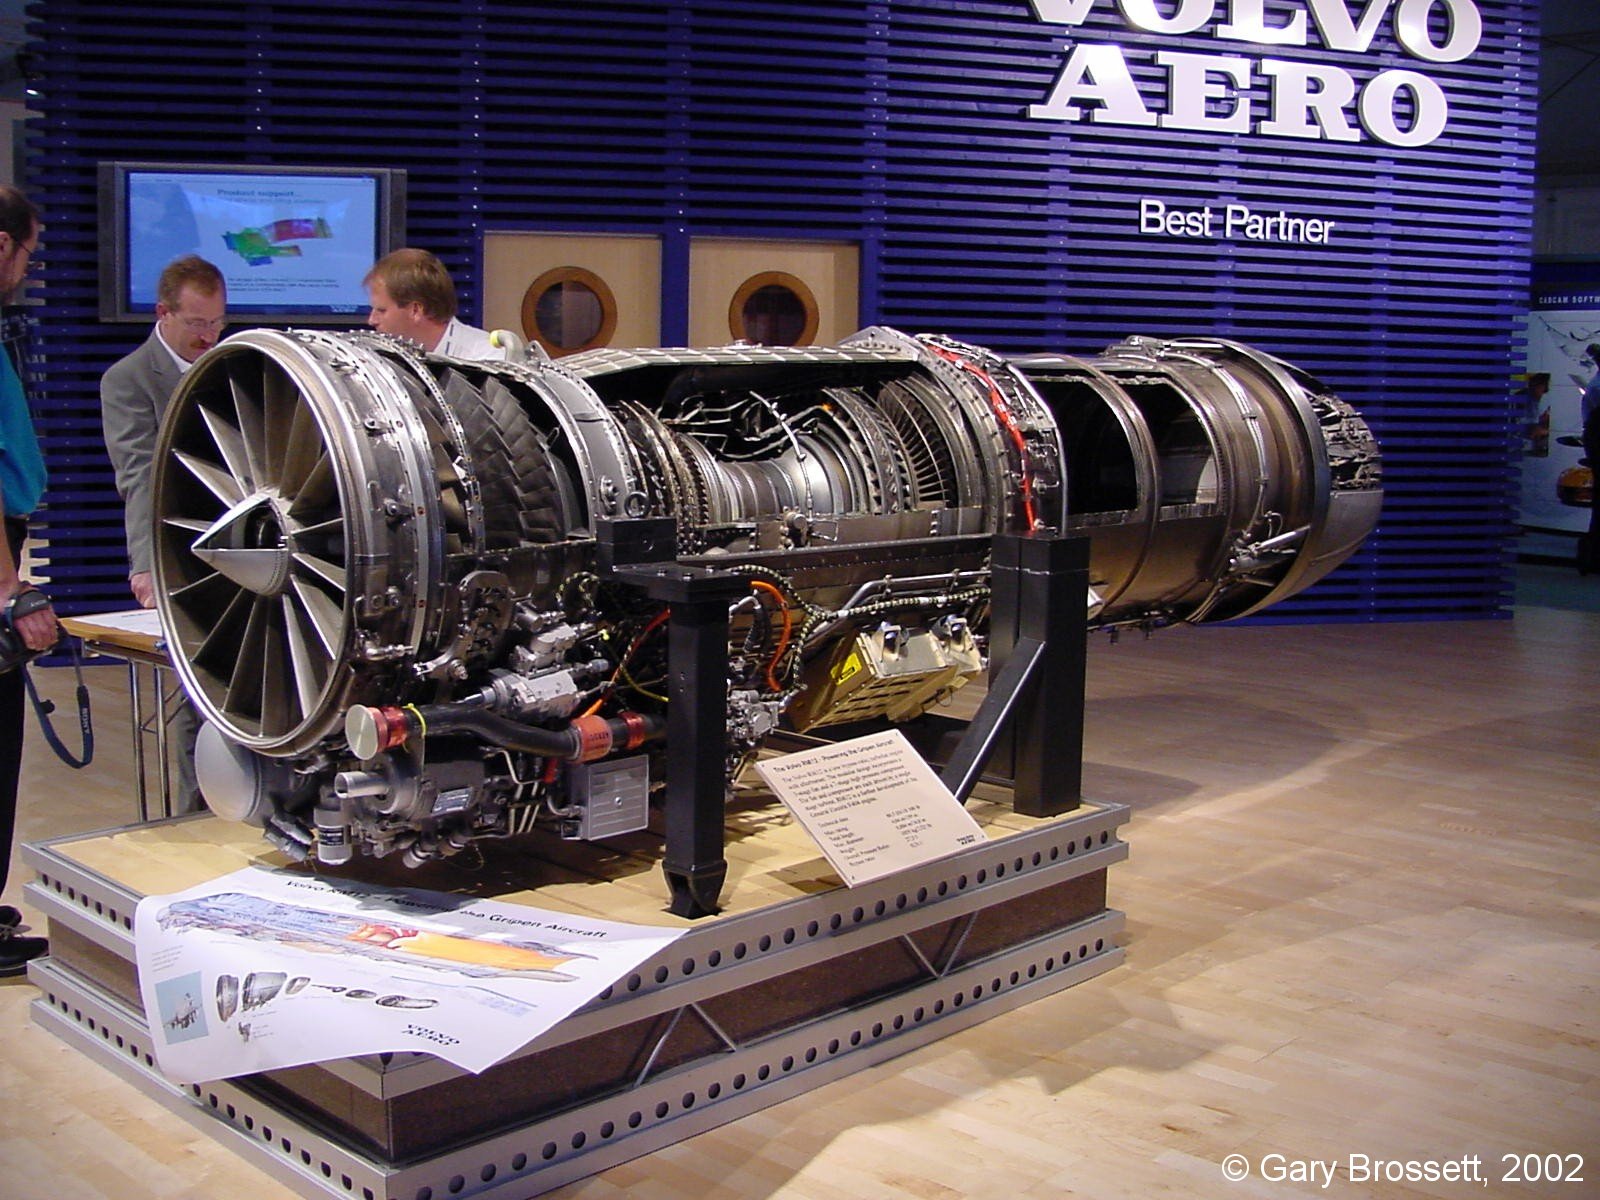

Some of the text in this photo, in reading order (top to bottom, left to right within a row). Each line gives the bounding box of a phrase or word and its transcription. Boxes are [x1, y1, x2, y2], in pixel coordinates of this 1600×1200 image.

[1028, 43, 1448, 147] AERO
[1140, 199, 1335, 244] Best Partner
[489, 913, 543, 928] Gripen
[545, 923, 608, 939] Aircraft
